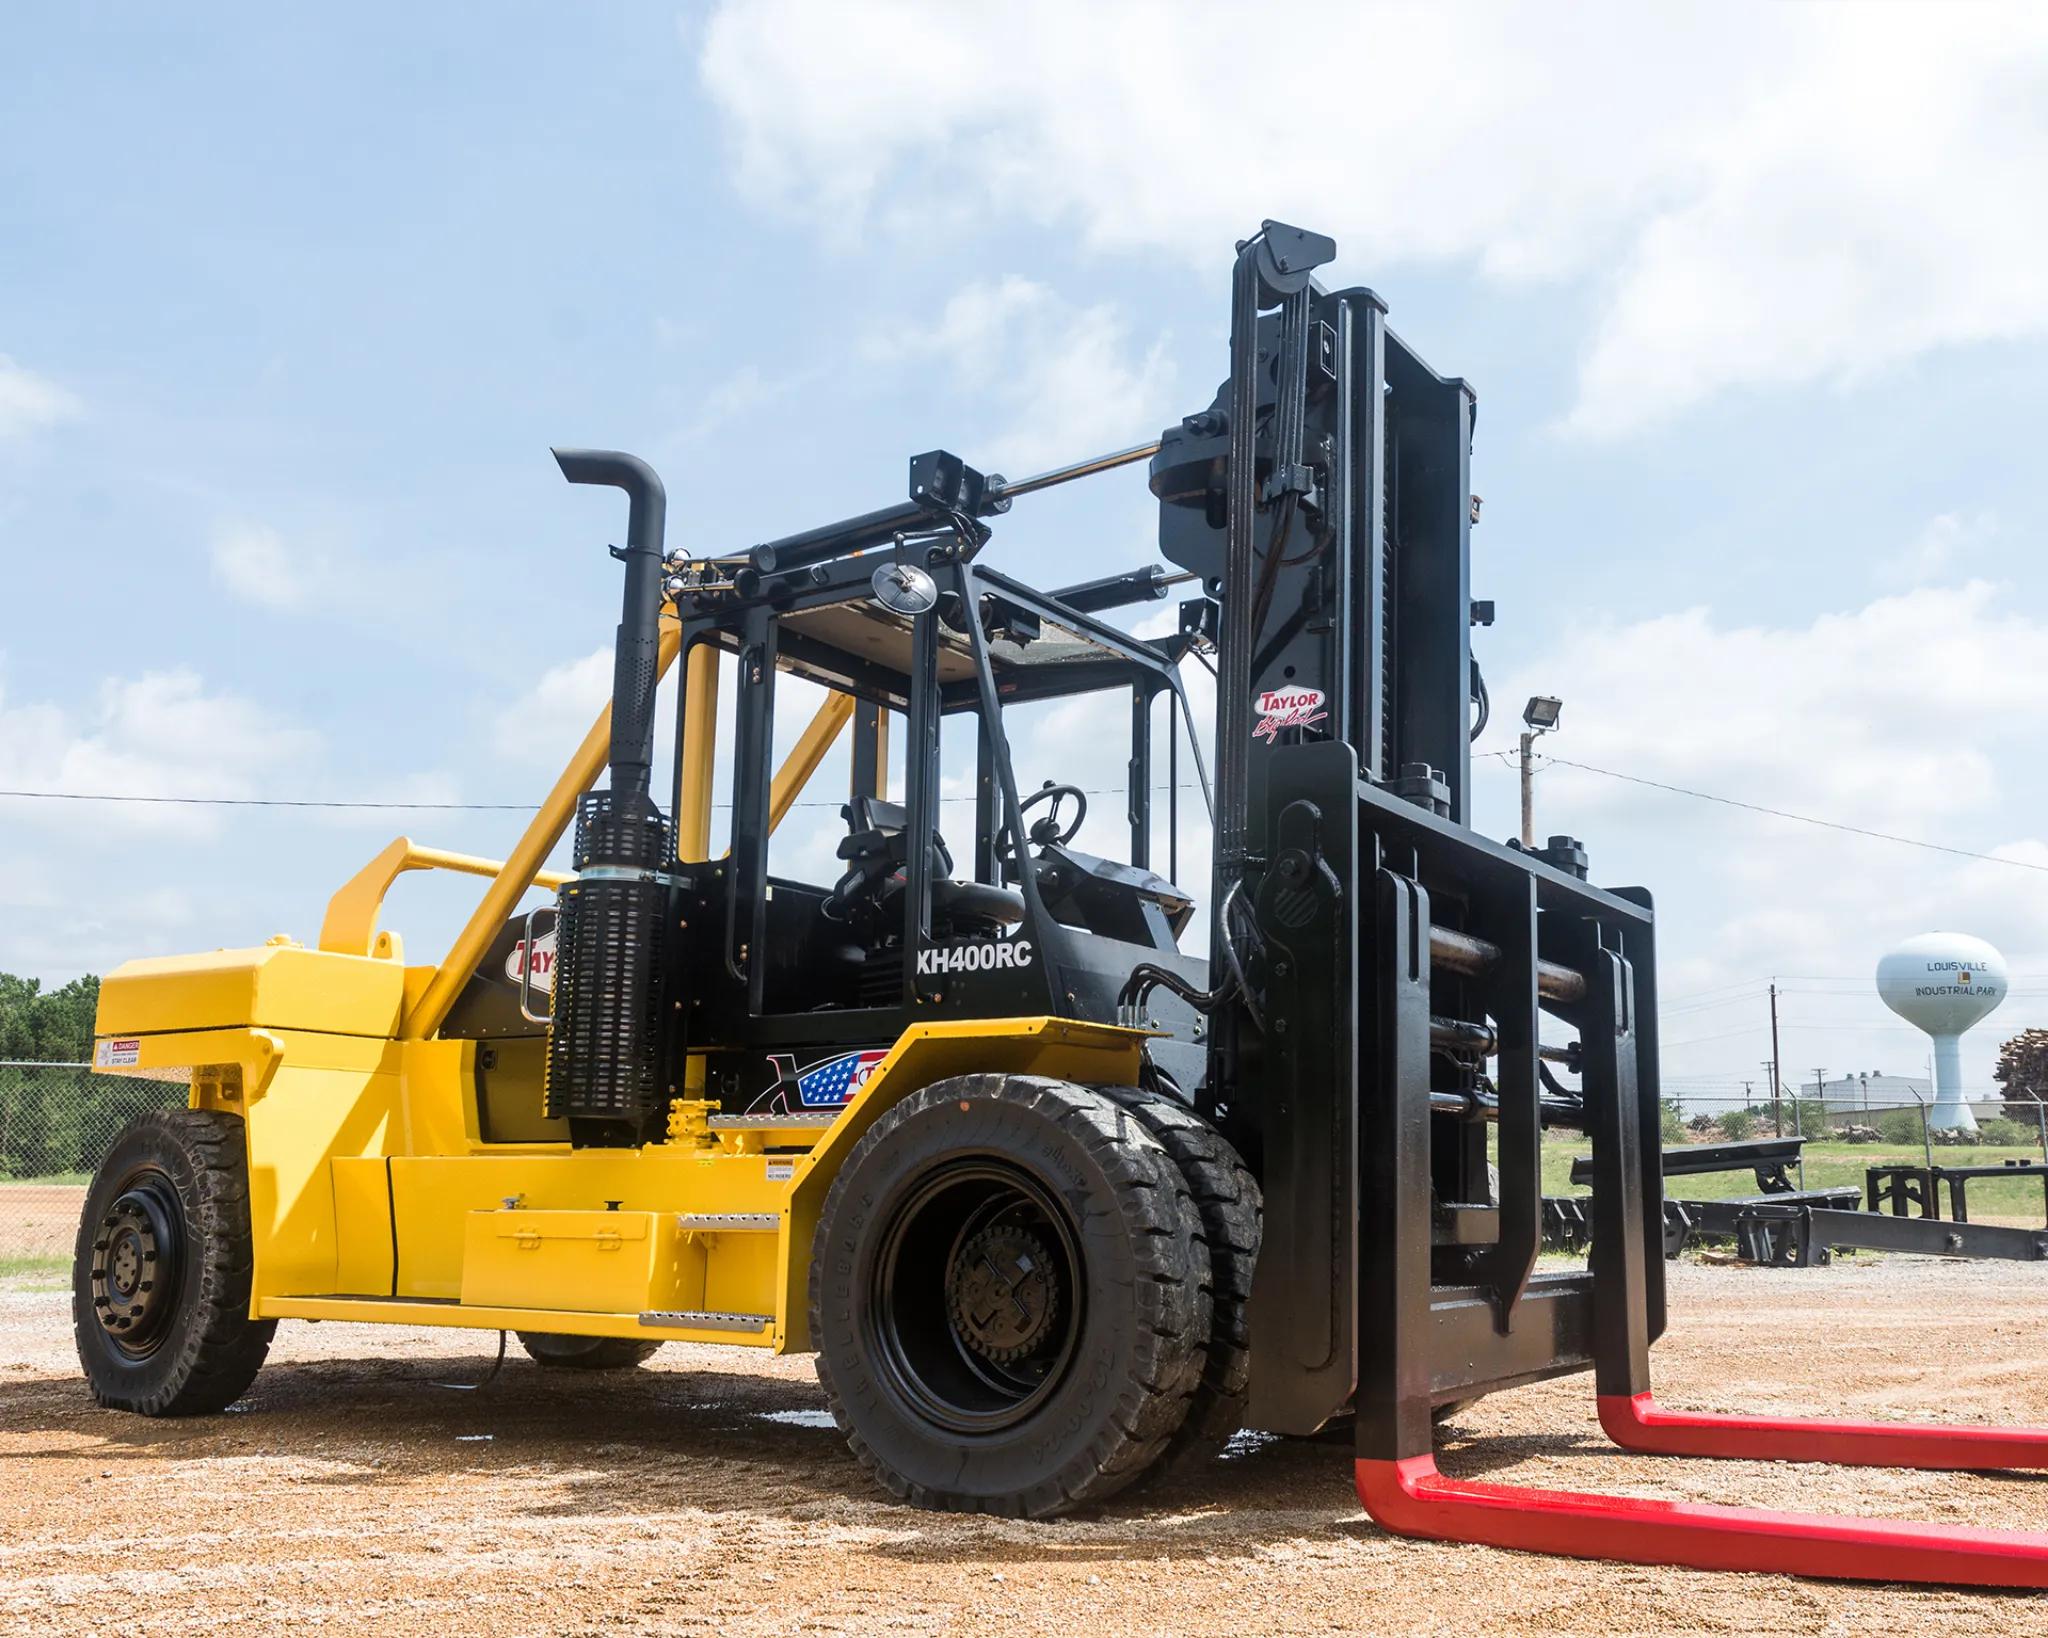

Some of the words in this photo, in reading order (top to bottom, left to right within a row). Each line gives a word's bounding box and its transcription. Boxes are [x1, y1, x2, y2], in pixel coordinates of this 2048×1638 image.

[1262, 693, 1318, 711] TAYLOR
[517, 941, 555, 975] TAY
[916, 940, 1032, 975] XH400RC
[1927, 962, 1987, 971] LOUISVILLE
[1915, 986, 1975, 996] INDUSTRIAL
[1976, 986, 1997, 996] PARK
